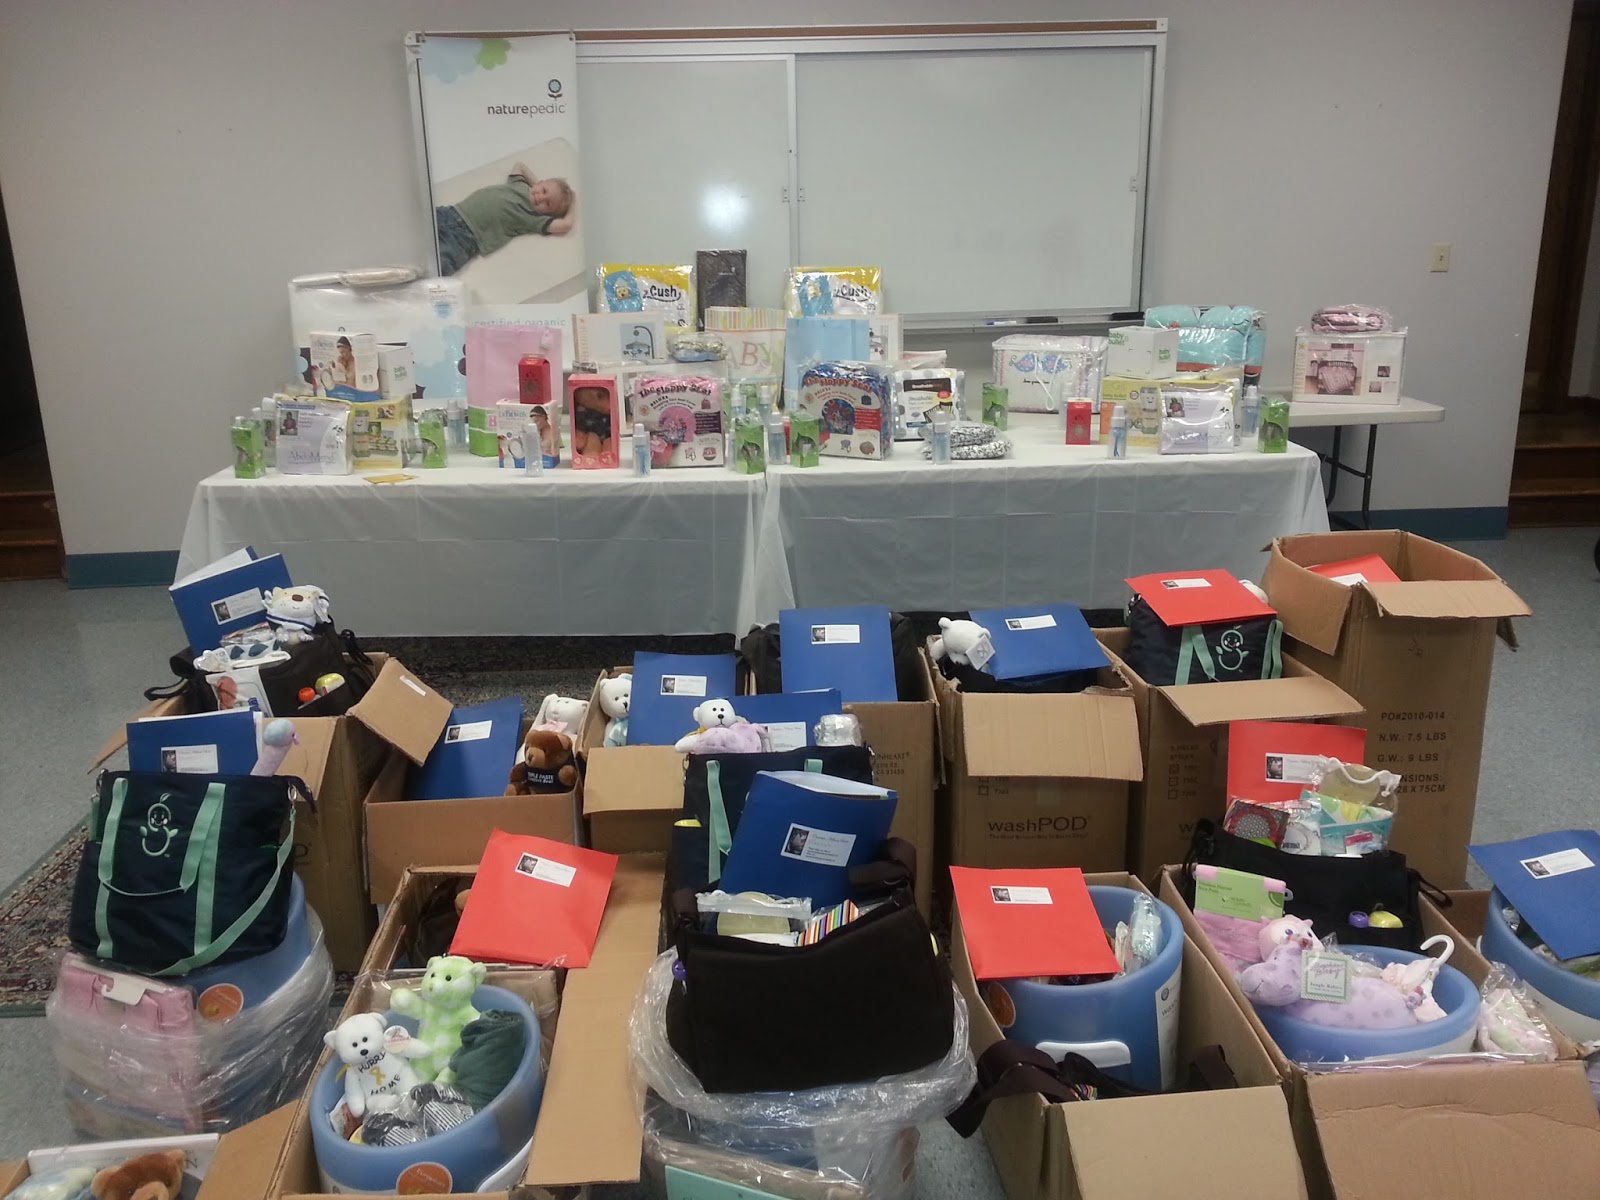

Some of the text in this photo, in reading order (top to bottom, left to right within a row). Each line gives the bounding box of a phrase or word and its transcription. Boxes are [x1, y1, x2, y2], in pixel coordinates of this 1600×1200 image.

[487, 103, 566, 118] naturepedic
[650, 285, 677, 298] Cush
[524, 317, 567, 326] organic
[727, 341, 772, 370] ABY
[1381, 711, 1445, 721] PO#2010-014
[1426, 732, 1447, 741] LBS
[876, 752, 905, 760] NHEART
[1408, 754, 1414, 762] 9
[1418, 753, 1439, 762] LBS
[1400, 773, 1442, 783] NSIONS:
[988, 816, 1088, 832] washPOD
[358, 1051, 386, 1073] HURRY
[370, 1074, 401, 1095] HOME
